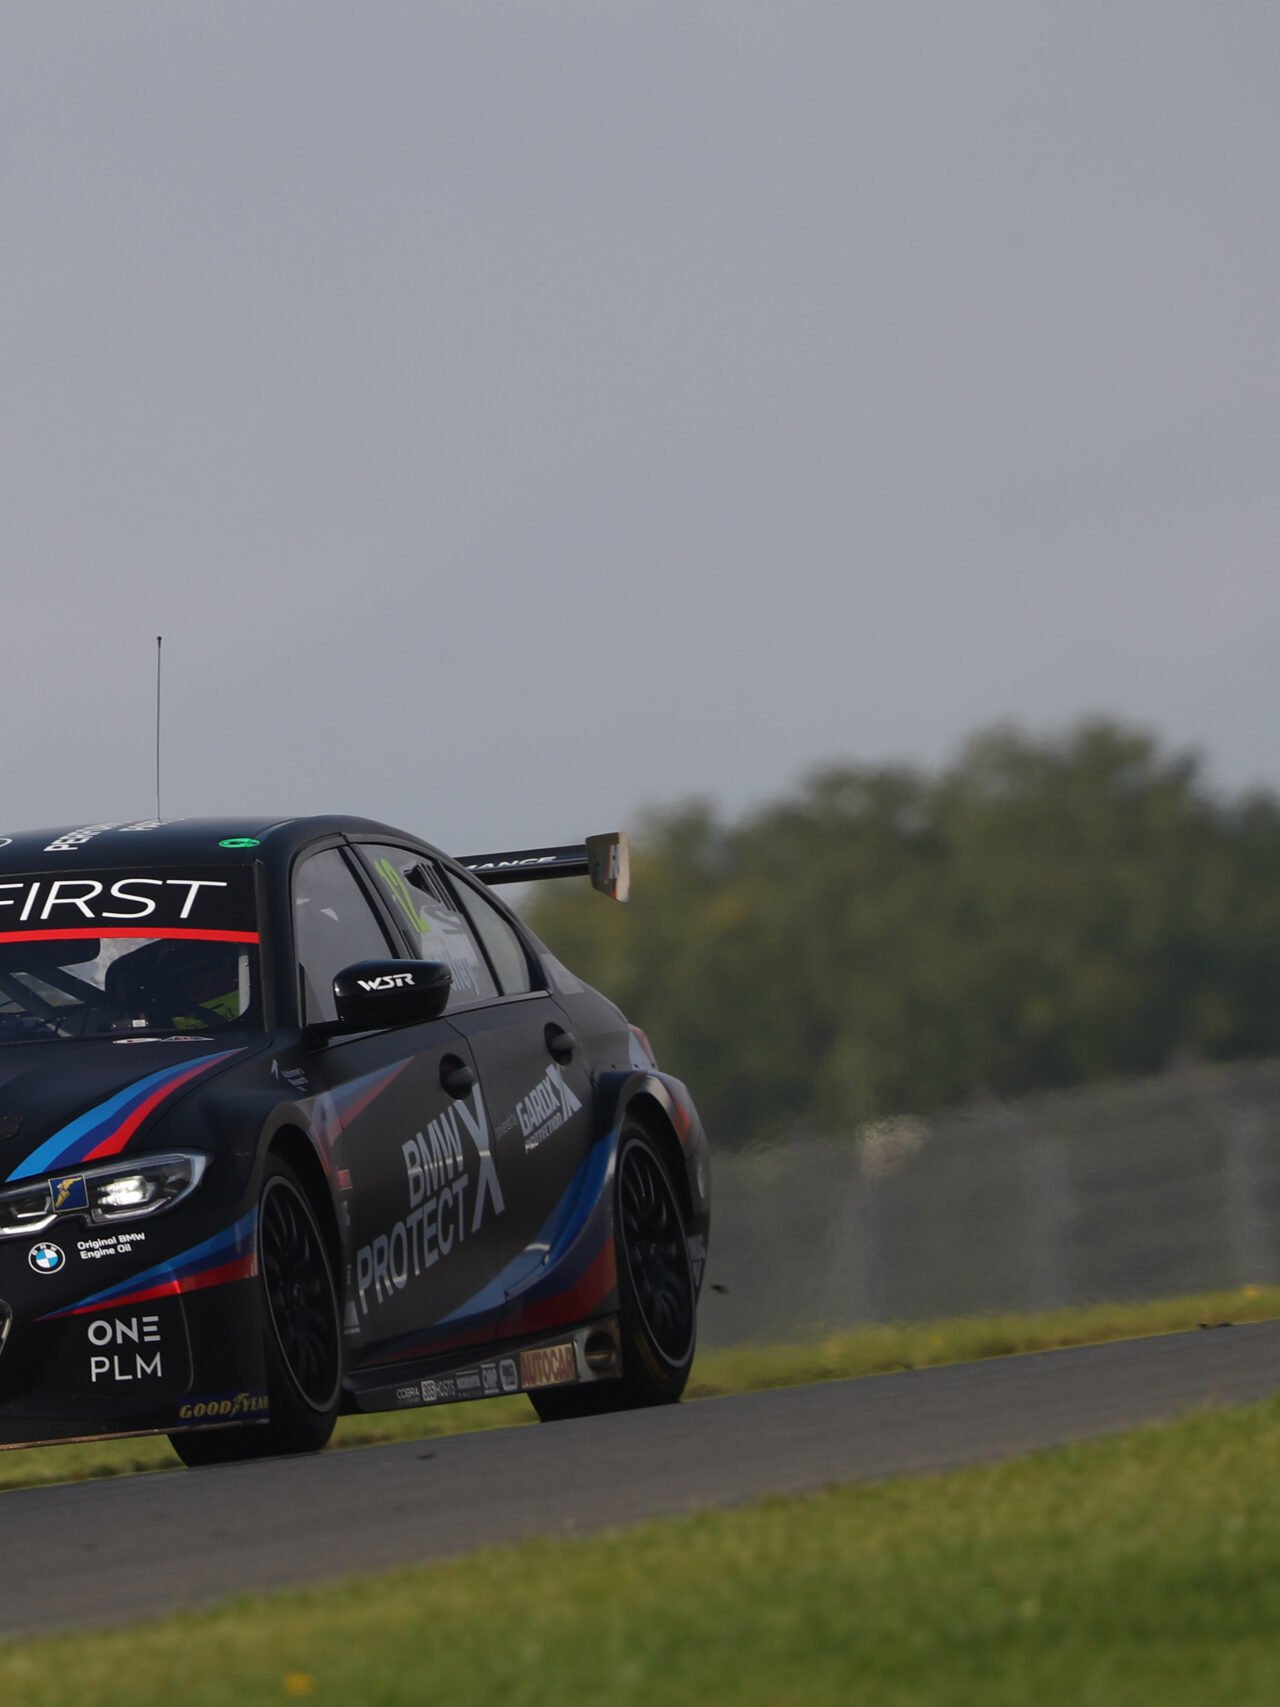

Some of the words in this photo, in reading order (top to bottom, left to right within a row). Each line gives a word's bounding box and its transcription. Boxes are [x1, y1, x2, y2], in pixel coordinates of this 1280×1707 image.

[356, 973, 415, 992] WSR
[402, 1106, 464, 1208] BMW
[453, 1082, 505, 1233] X
[77, 1235, 117, 1251] Original
[118, 1232, 145, 1243] BMW
[80, 1246, 115, 1260] Engine
[117, 1243, 132, 1253] Oil
[356, 1174, 468, 1315] PROTECT
[87, 1315, 161, 1346] ONE
[90, 1352, 162, 1382] PLM
